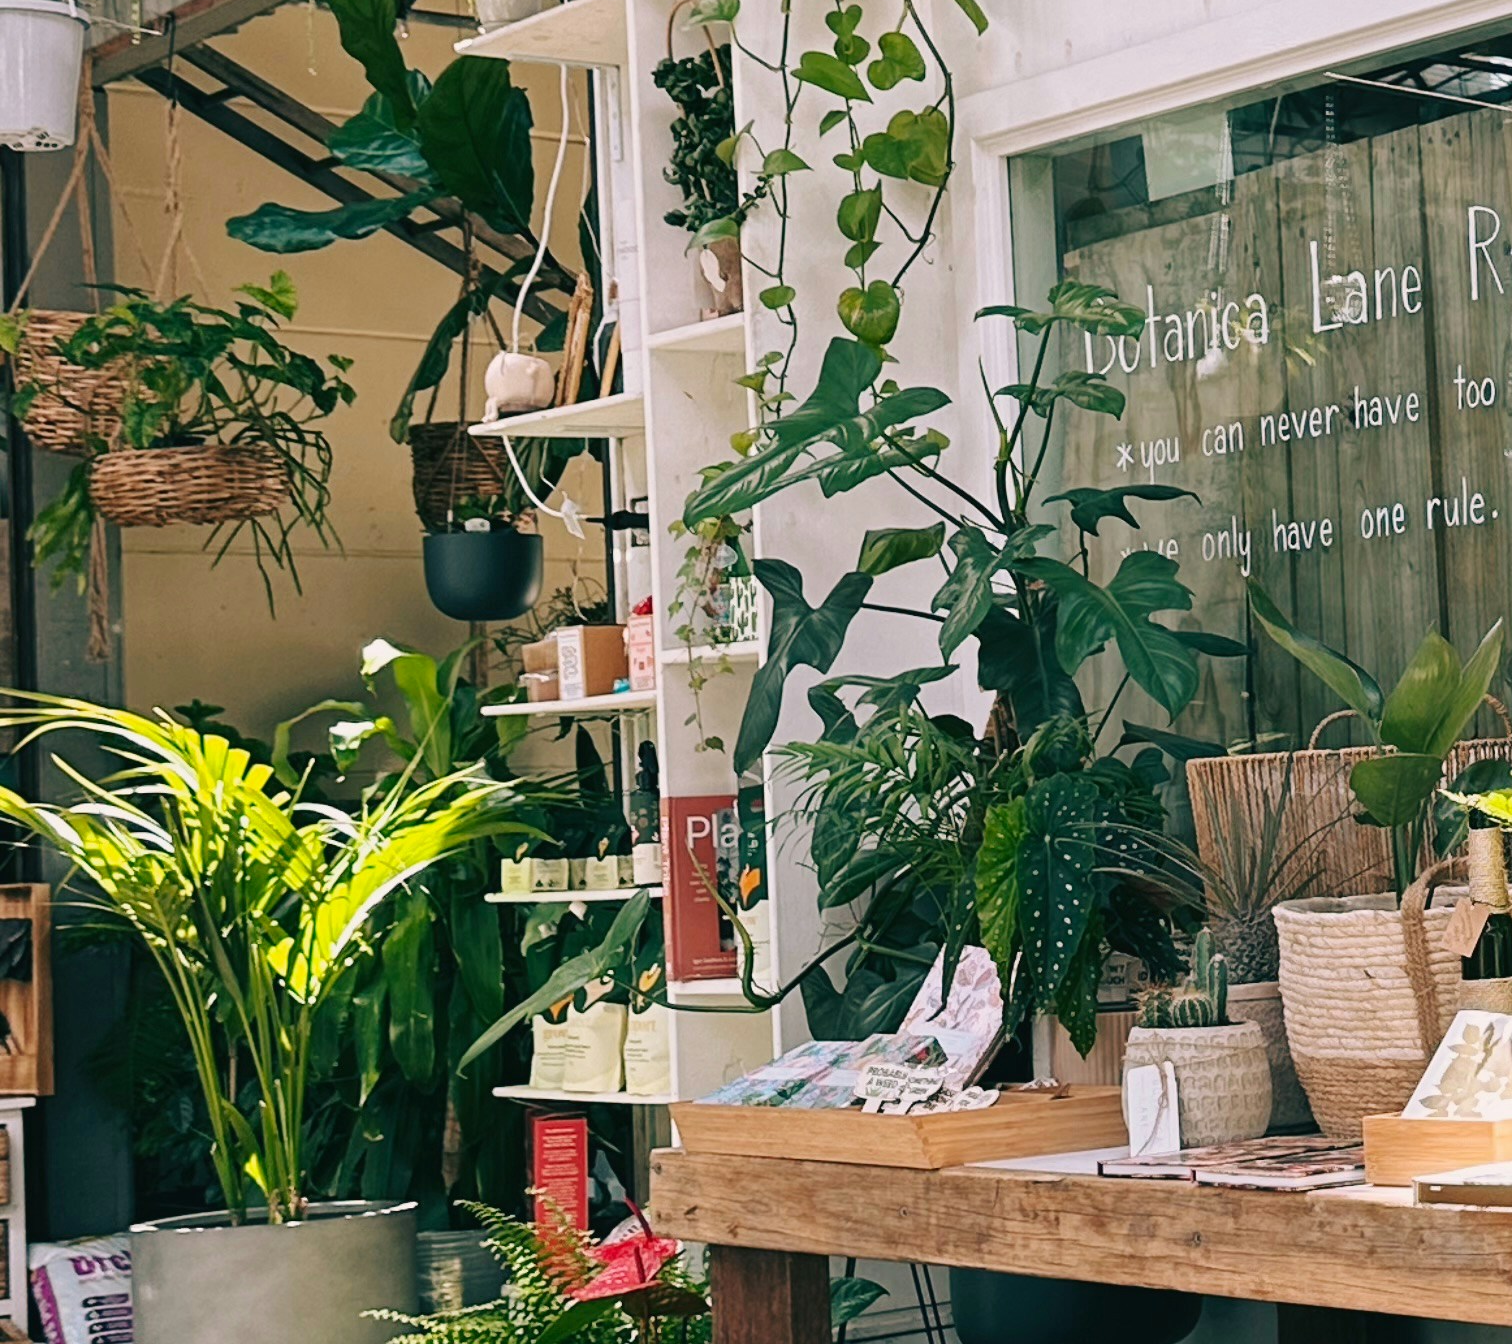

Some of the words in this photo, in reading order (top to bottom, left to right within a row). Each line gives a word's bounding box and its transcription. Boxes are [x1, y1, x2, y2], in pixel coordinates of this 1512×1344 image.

[1309, 240, 1423, 334] Lane
[1202, 421, 1244, 456] can
[1261, 404, 1340, 446] never
[1353, 385, 1419, 430] have
[1453, 364, 1495, 410] too
[1201, 515, 1251, 577] only
[1271, 508, 1334, 553] have
[1361, 503, 1406, 540] one
[1426, 476, 1498, 530] rule.
[686, 813, 741, 849] Pla
